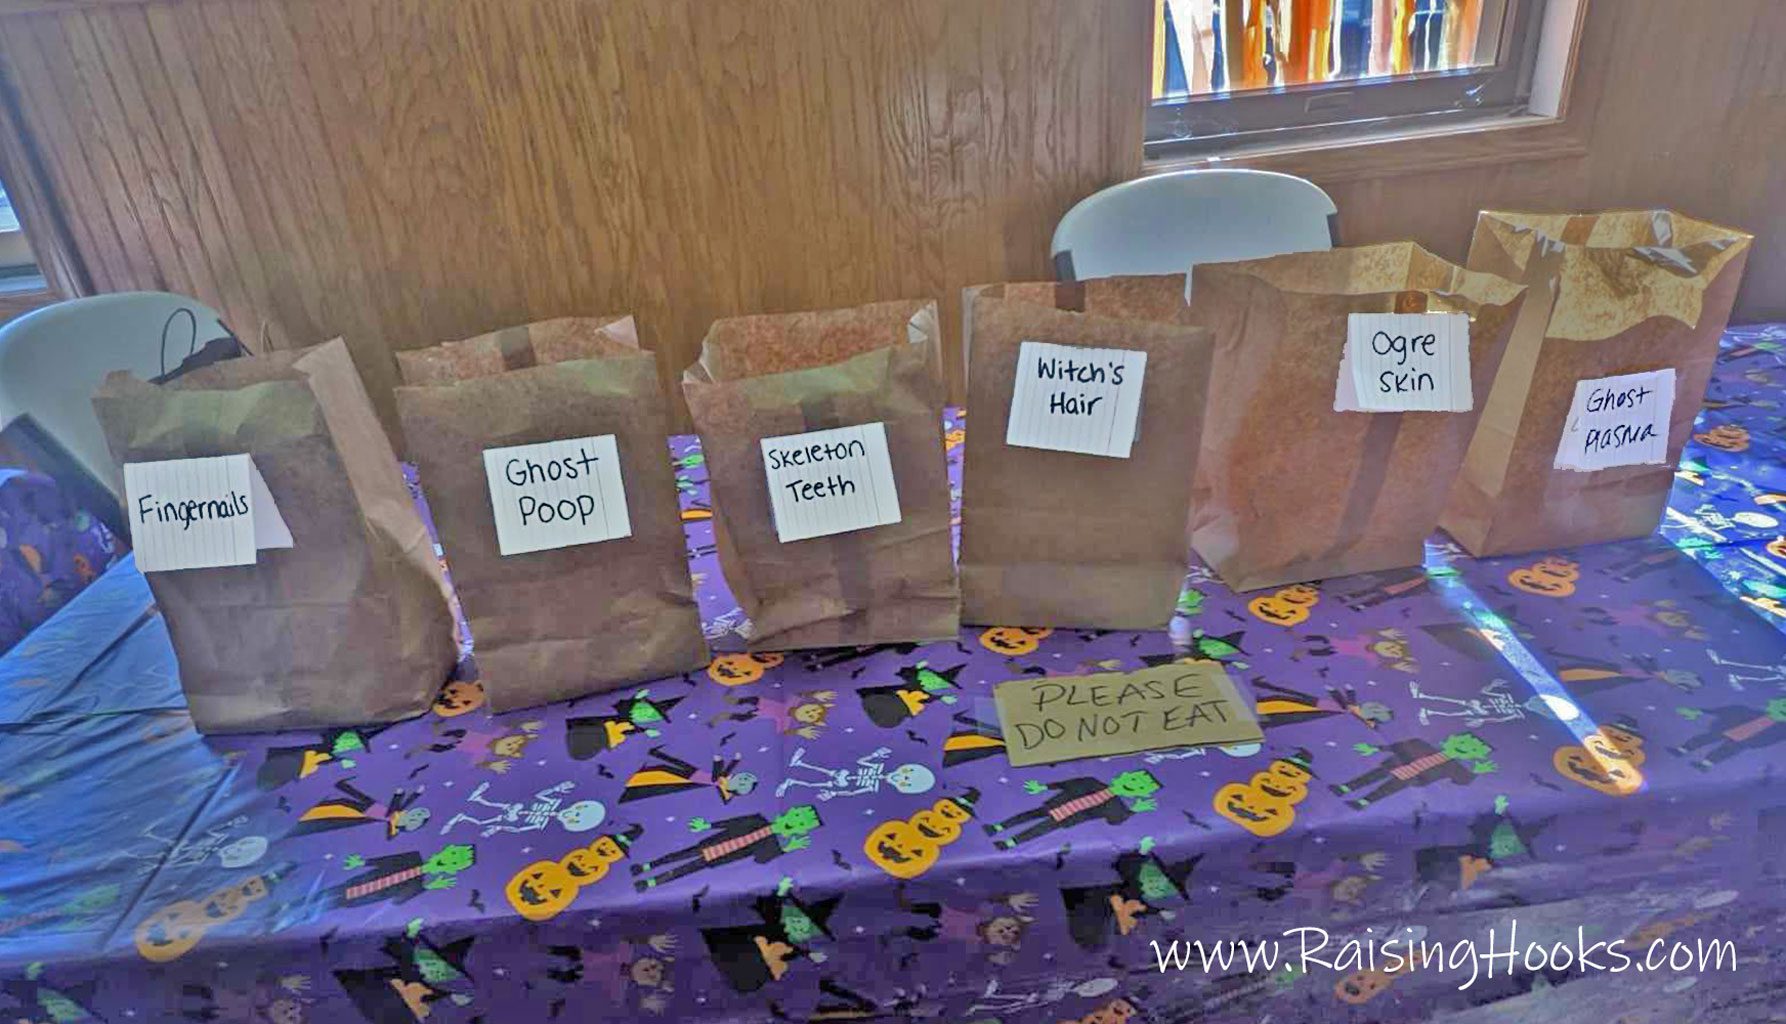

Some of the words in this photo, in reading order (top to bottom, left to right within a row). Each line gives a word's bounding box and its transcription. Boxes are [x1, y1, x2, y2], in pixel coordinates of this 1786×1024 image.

[1371, 330, 1436, 366] Ogre
[1037, 356, 1125, 386] Witch's
[1049, 391, 1103, 416] Hair
[1586, 386, 1653, 413] Ghost
[506, 447, 599, 486] Ghost
[768, 439, 865, 470] Skeleton
[785, 474, 856, 503] Teeth
[138, 490, 249, 531] Fingernails
[518, 494, 595, 526] Poop
[1031, 673, 1201, 712] PLEASE
[1015, 718, 1065, 750] DO
[1077, 710, 1148, 742] NOT
[1162, 699, 1228, 731] EAT
